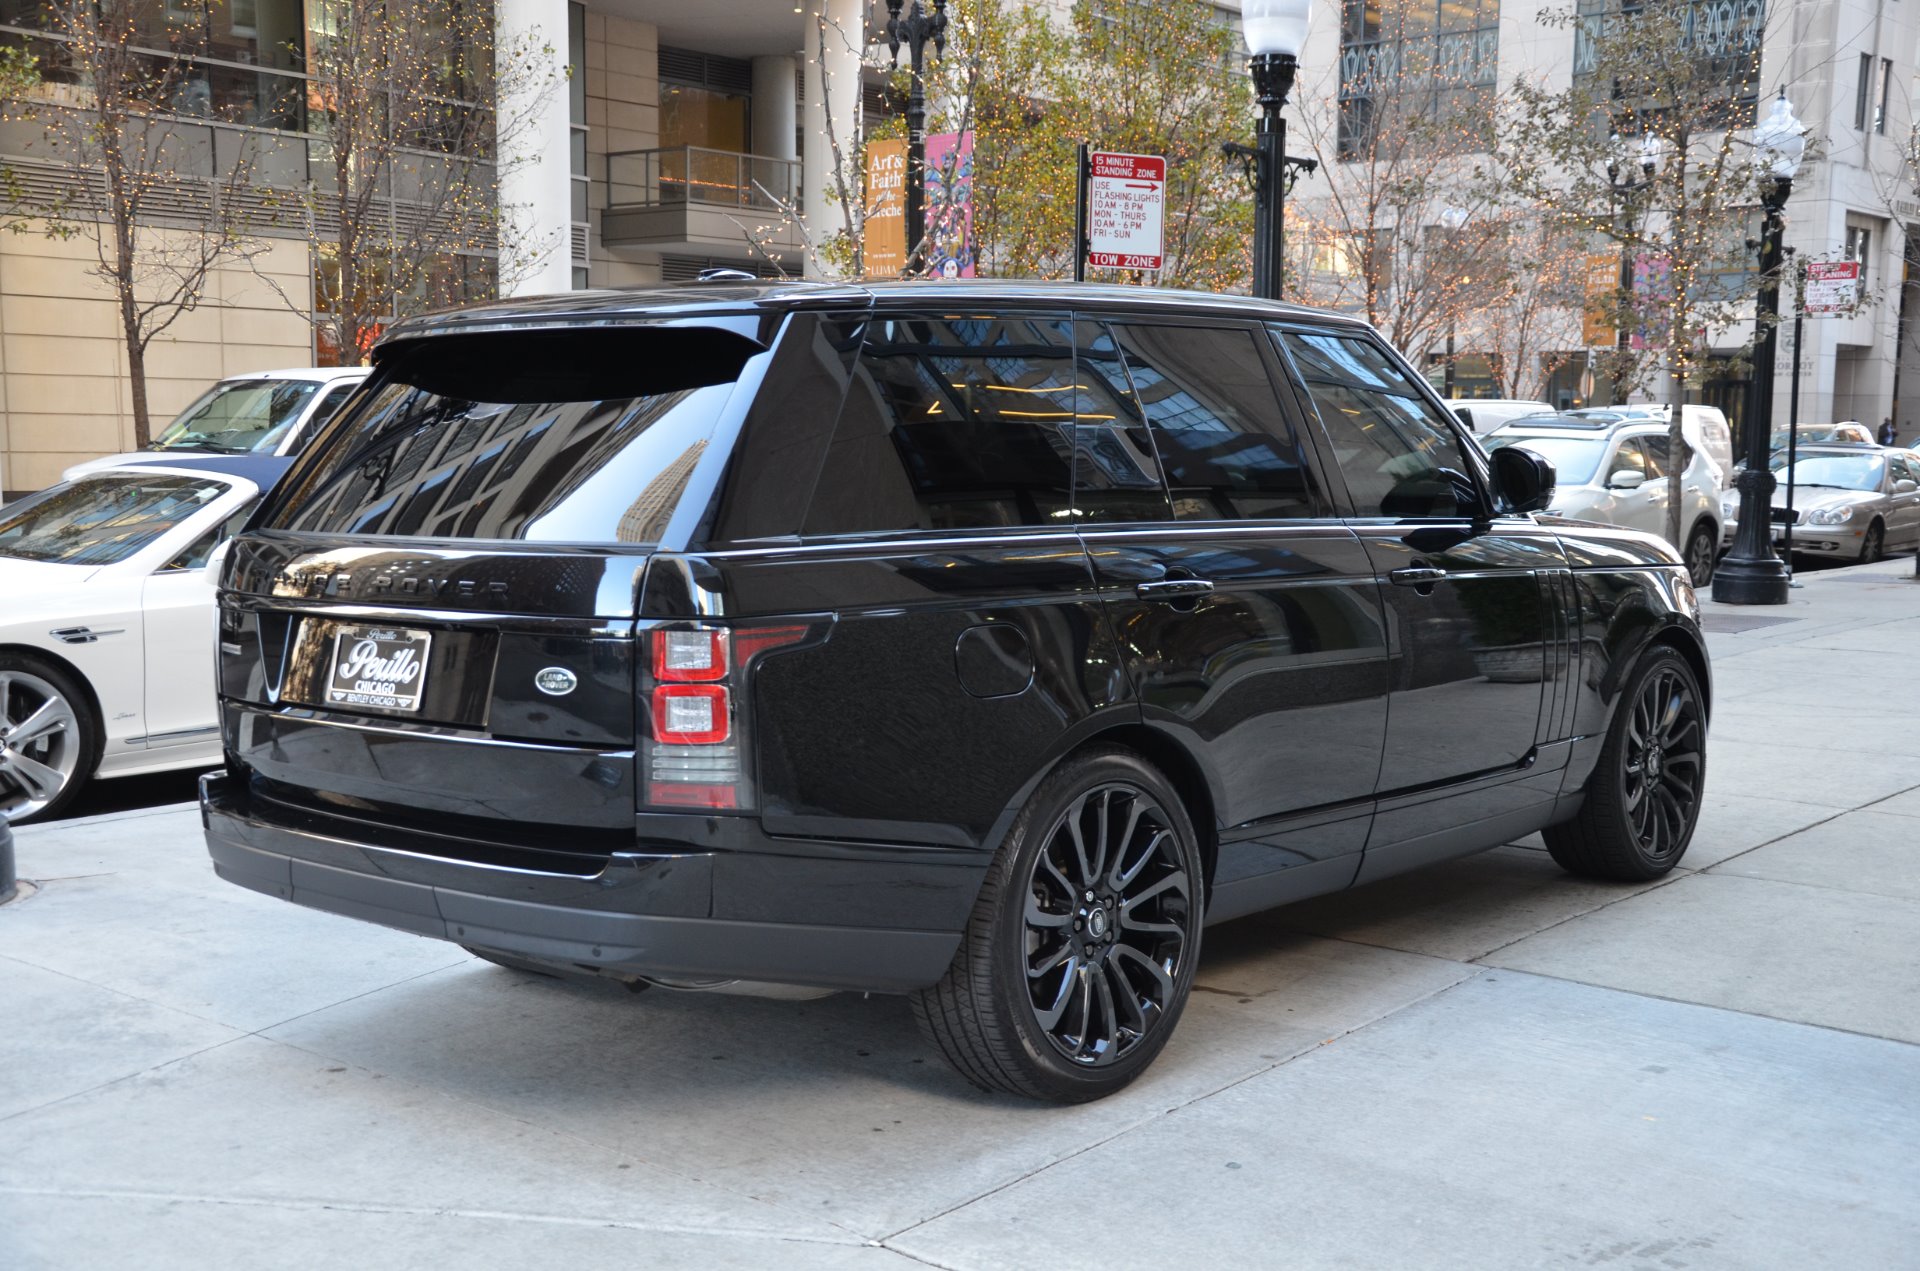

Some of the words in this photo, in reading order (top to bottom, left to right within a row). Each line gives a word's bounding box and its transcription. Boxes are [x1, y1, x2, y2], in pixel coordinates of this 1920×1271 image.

[870, 155, 893, 171] Art
[894, 155, 904, 169] &
[1096, 156, 1103, 165] 15
[1106, 157, 1134, 167] MINUTE
[1096, 166, 1132, 177] STANDING
[1136, 169, 1157, 179] ZONE
[870, 171, 901, 190] Faith
[1094, 192, 1132, 201] FLASHING
[1134, 194, 1160, 203] LIGHTS
[1094, 200, 1103, 208] 10
[1104, 201, 1116, 209] AM
[1094, 210, 1111, 218] MON
[1120, 212, 1146, 220] THURS
[1103, 220, 1115, 228] AM
[1130, 222, 1142, 230] PM
[1094, 228, 1106, 236] FRI
[1114, 230, 1130, 238] SUN
[1093, 254, 1118, 265] TOW
[1124, 256, 1156, 268] ZONE
[872, 265, 897, 275] LUMA
[1810, 264, 1840, 272] STRT
[1774, 362, 1815, 370] OROY
[375, 576, 509, 601] ROVER
[367, 628, 397, 640] Perillo
[339, 640, 420, 684] Perillo
[354, 680, 396, 694] CHICAGO
[347, 693, 370, 704] BENTLEY
[370, 694, 396, 706] CHICAGO
